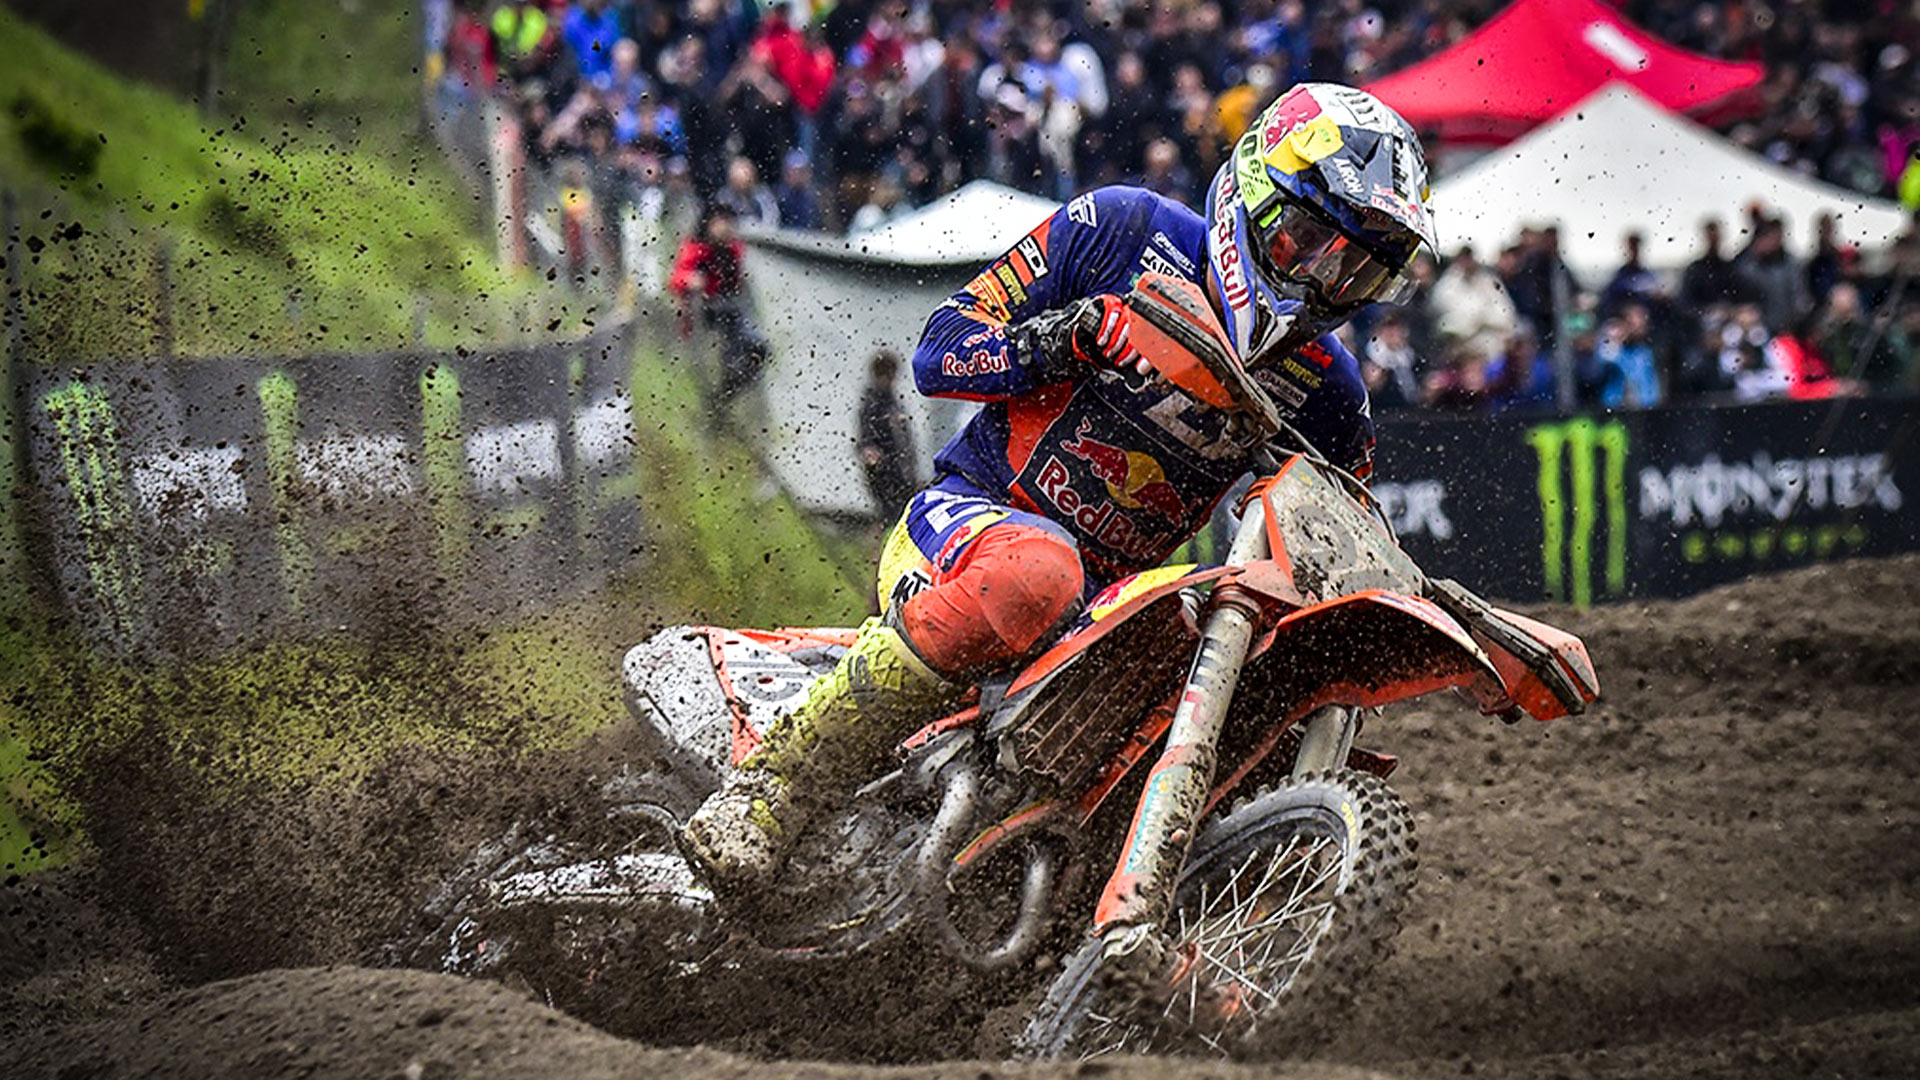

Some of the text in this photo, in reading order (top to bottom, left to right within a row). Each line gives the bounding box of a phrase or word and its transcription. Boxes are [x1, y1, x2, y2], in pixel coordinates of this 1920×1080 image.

[1219, 243, 1251, 312] Bull
[1035, 454, 1173, 559] Red Bull
[890, 569, 933, 604] KT
